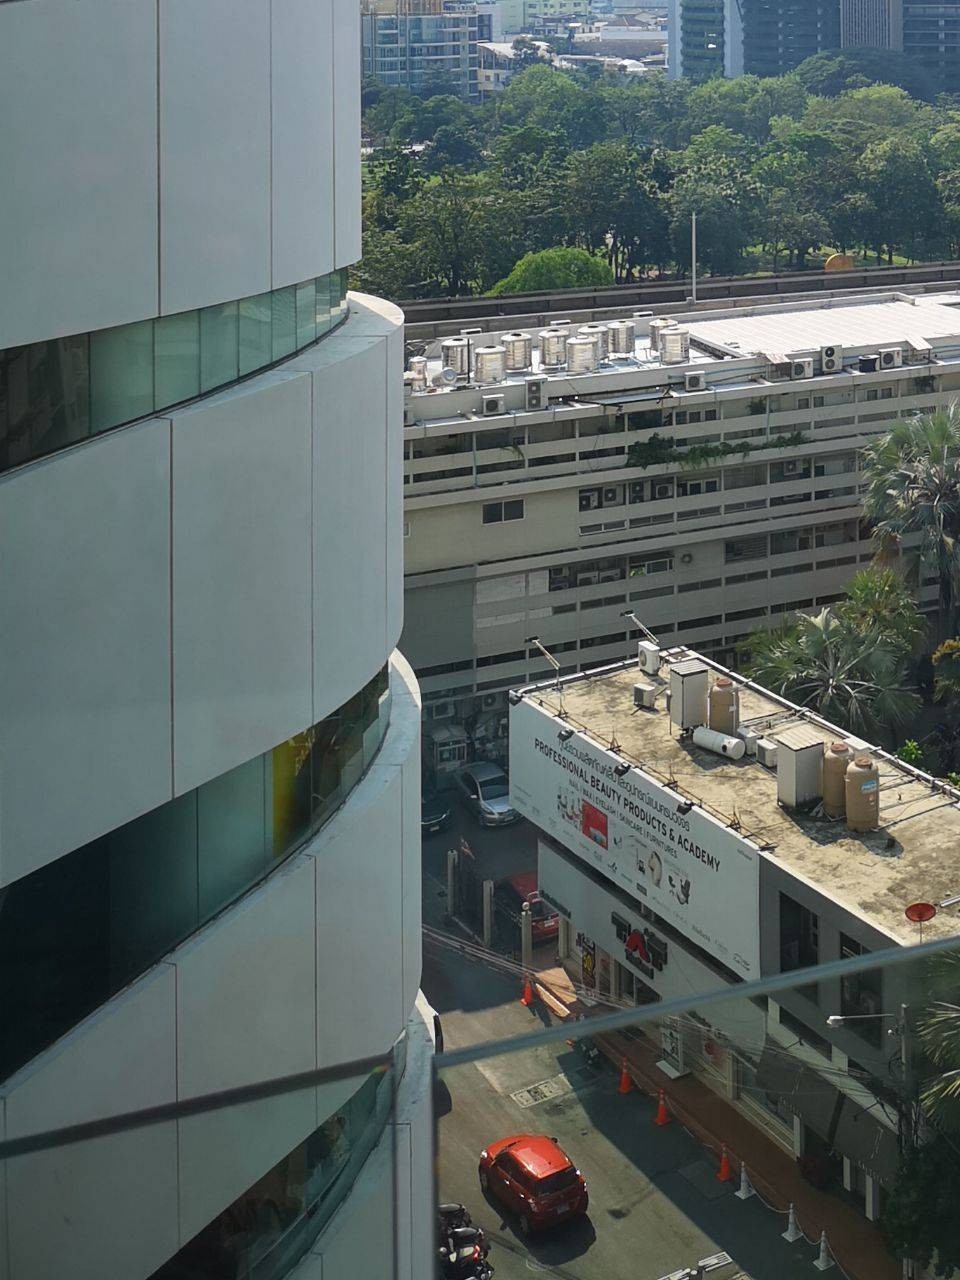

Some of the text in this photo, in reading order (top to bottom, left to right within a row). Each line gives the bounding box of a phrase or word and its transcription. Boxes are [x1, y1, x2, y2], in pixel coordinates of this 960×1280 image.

[534, 738, 720, 872] PROFESSIONAL BEAUTY PRODUCTS & ACADEMY
